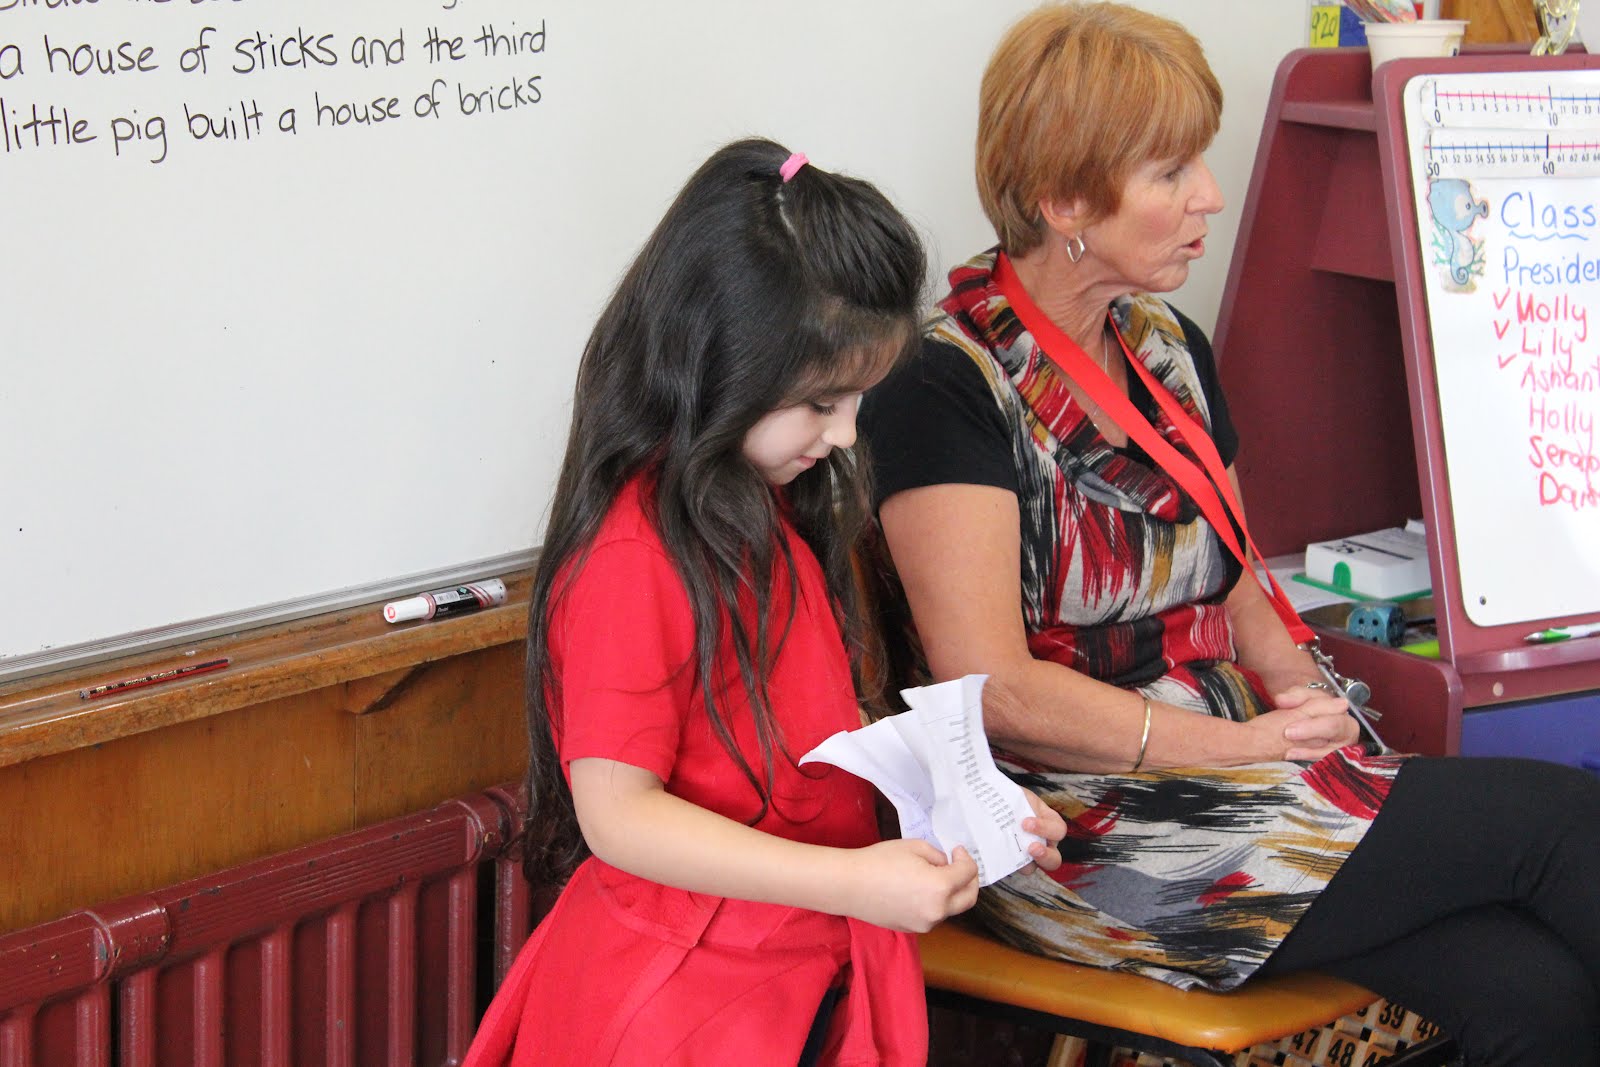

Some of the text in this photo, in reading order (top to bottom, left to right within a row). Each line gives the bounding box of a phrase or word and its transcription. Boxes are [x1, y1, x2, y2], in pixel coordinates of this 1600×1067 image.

[1312, 11, 1337, 45] 920
[0, 19, 546, 79] a house of sticks and the third
[0, 75, 542, 164] little pig built a house of bricks
[1434, 109, 1441, 123] 0
[1459, 102, 1463, 112] 2
[1548, 112, 1559, 126] 10
[1572, 105, 1579, 114] 12
[1427, 162, 1440, 176] 50
[1486, 154, 1495, 164] 55
[1542, 161, 1555, 175] 60
[1500, 191, 1596, 228] Class
[1516, 291, 1588, 343] Molly
[1521, 326, 1573, 374] Lily
[1529, 396, 1593, 458] Holly
[1379, 1001, 1406, 1029] 39
[1292, 1029, 1320, 1054] 47
[1328, 1039, 1356, 1067] 48
